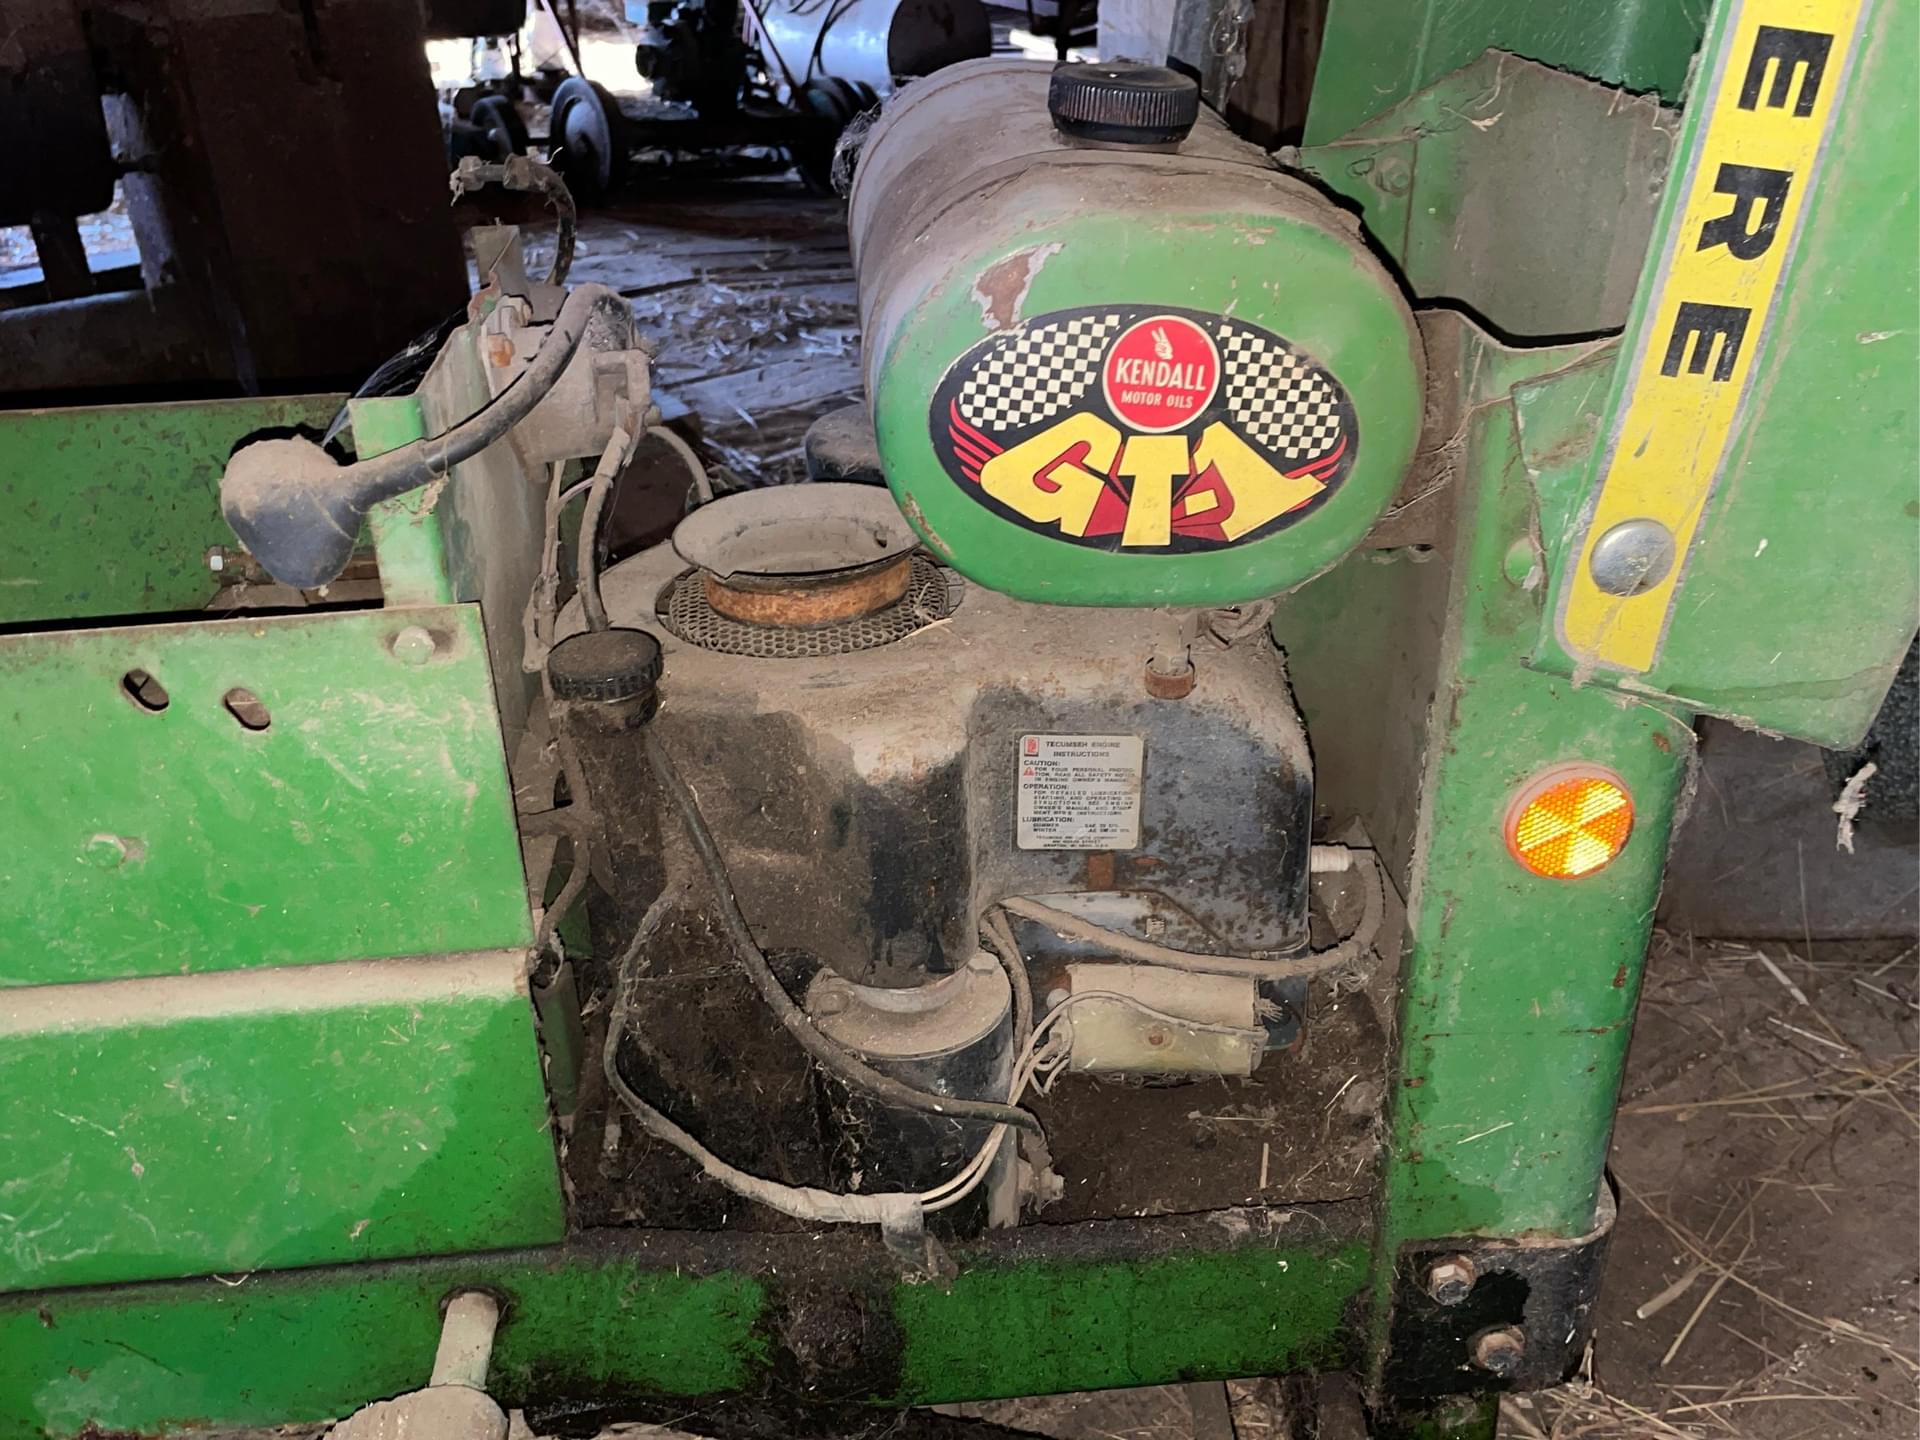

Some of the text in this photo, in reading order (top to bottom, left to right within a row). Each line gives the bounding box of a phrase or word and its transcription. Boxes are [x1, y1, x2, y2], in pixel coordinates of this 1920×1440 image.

[1661, 25, 1834, 382] ERE
[1115, 357, 1206, 391] KENDALL
[1121, 390, 1193, 409] MOTOR OILS
